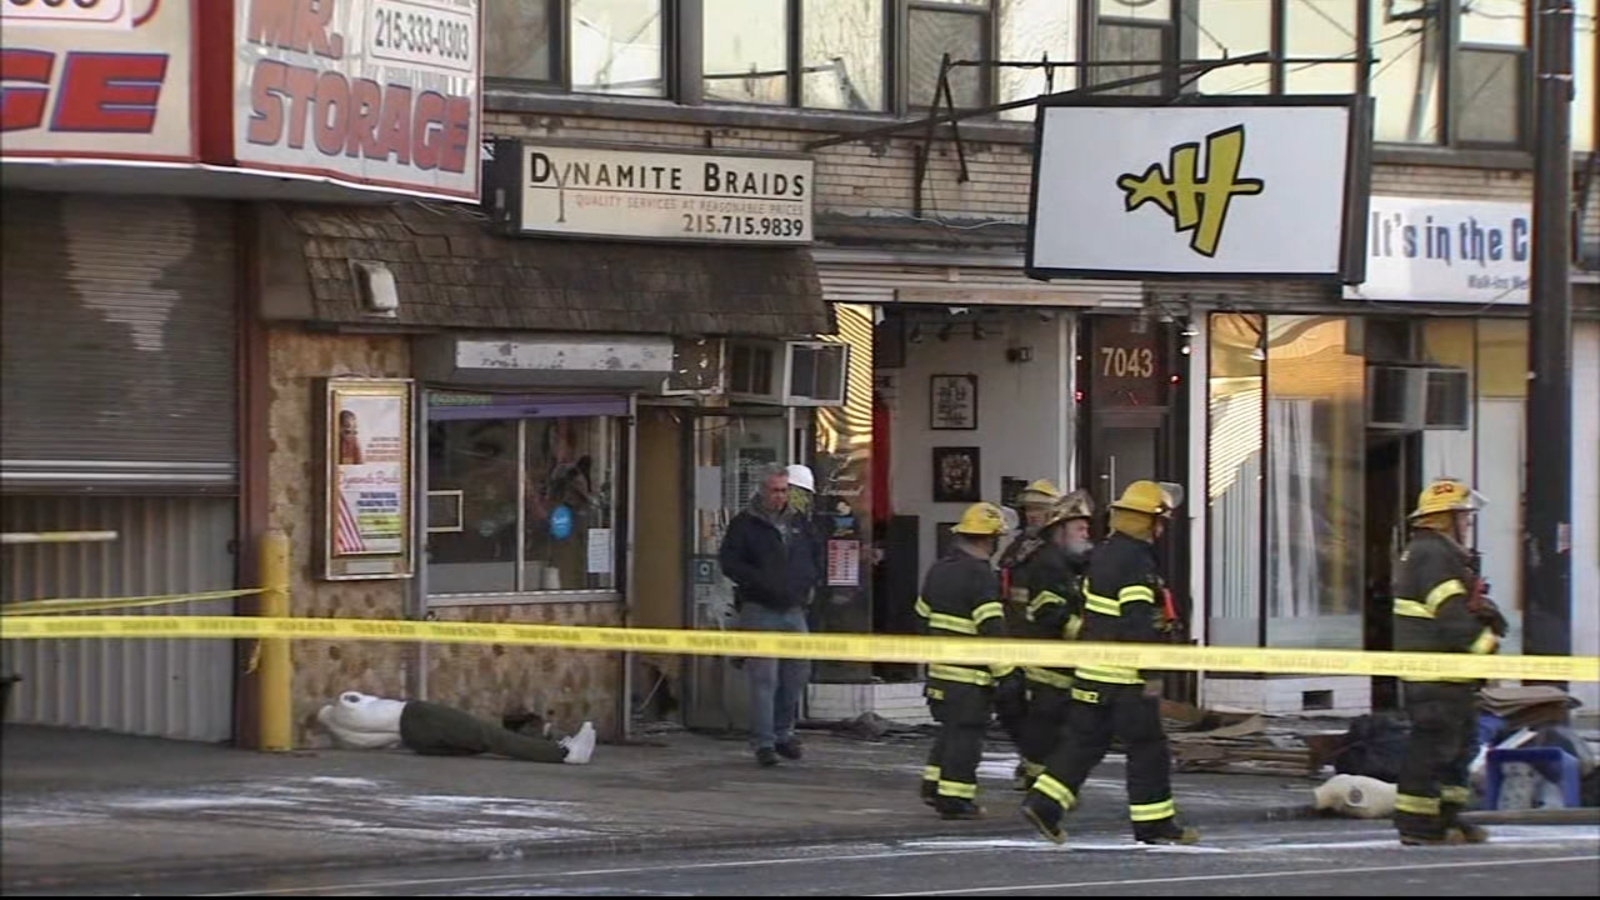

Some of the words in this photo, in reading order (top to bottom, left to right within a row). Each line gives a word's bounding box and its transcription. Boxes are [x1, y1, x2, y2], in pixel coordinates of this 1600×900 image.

[247, 0, 344, 60] MR.
[375, 8, 469, 61] 215-333-0303
[248, 58, 470, 174] STORAGE
[531, 152, 682, 222] DYNAMITE
[704, 162, 805, 196] BRAIDS
[576, 194, 620, 209] QUALITY
[627, 196, 676, 209] SERVICES
[682, 199, 694, 210] AT
[701, 200, 764, 214] REASONABLE
[769, 203, 803, 216] PRICES
[683, 213, 804, 237] 215.715.9839
[1372, 211, 1417, 258] It's
[1426, 215, 1450, 266] in
[1459, 217, 1503, 267] the
[1101, 347, 1153, 378] 7043
